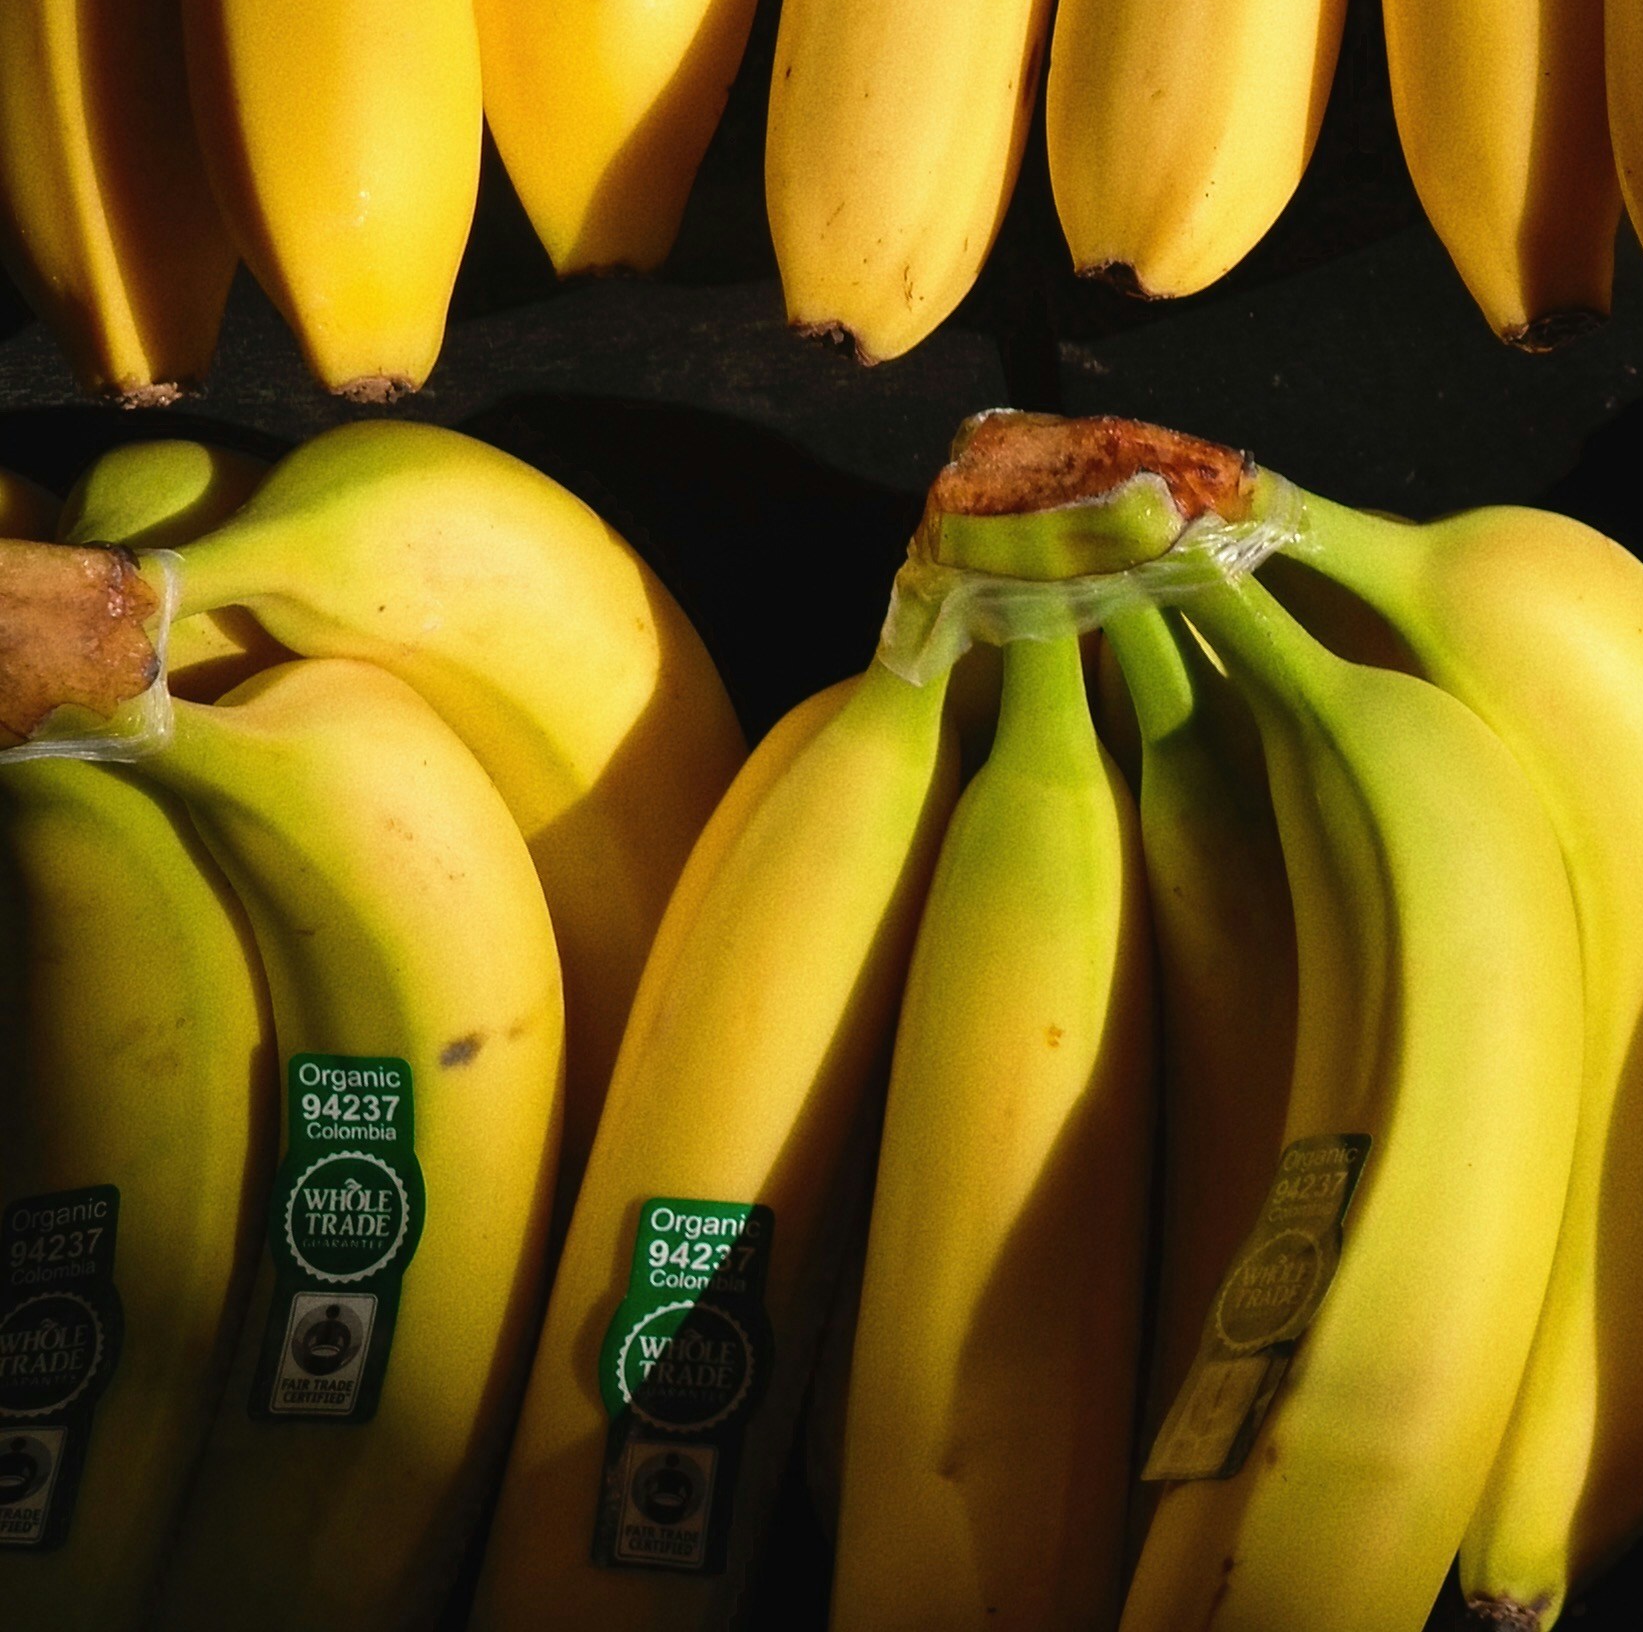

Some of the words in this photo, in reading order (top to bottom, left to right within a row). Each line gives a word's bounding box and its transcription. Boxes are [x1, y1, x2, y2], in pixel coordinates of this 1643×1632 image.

[299, 1062, 401, 1091] Organic
[302, 1094, 400, 1121] 94237
[307, 1122, 397, 1141] Colombia
[302, 1185, 393, 1212] WHOLE
[11, 1198, 108, 1235] Organic
[306, 1213, 390, 1237] TRADE
[650, 1207, 761, 1240] Organic
[10, 1227, 103, 1268] 94237
[302, 1238, 384, 1249] GUARANTEE
[648, 1240, 756, 1271] 94237
[11, 1259, 96, 1286] Colombia
[649, 1269, 746, 1293] Colombia
[0, 1321, 88, 1352] WHOLE
[639, 1332, 737, 1366] WHOLE
[0, 1350, 85, 1376] TRADE
[640, 1360, 733, 1389] TRADE
[282, 1378, 310, 1391] FAIR
[314, 1379, 353, 1392] TRADE
[626, 1525, 656, 1538] FAIR
[660, 1528, 699, 1542] TRADE
[629, 1539, 693, 1555] CERTIFIED
